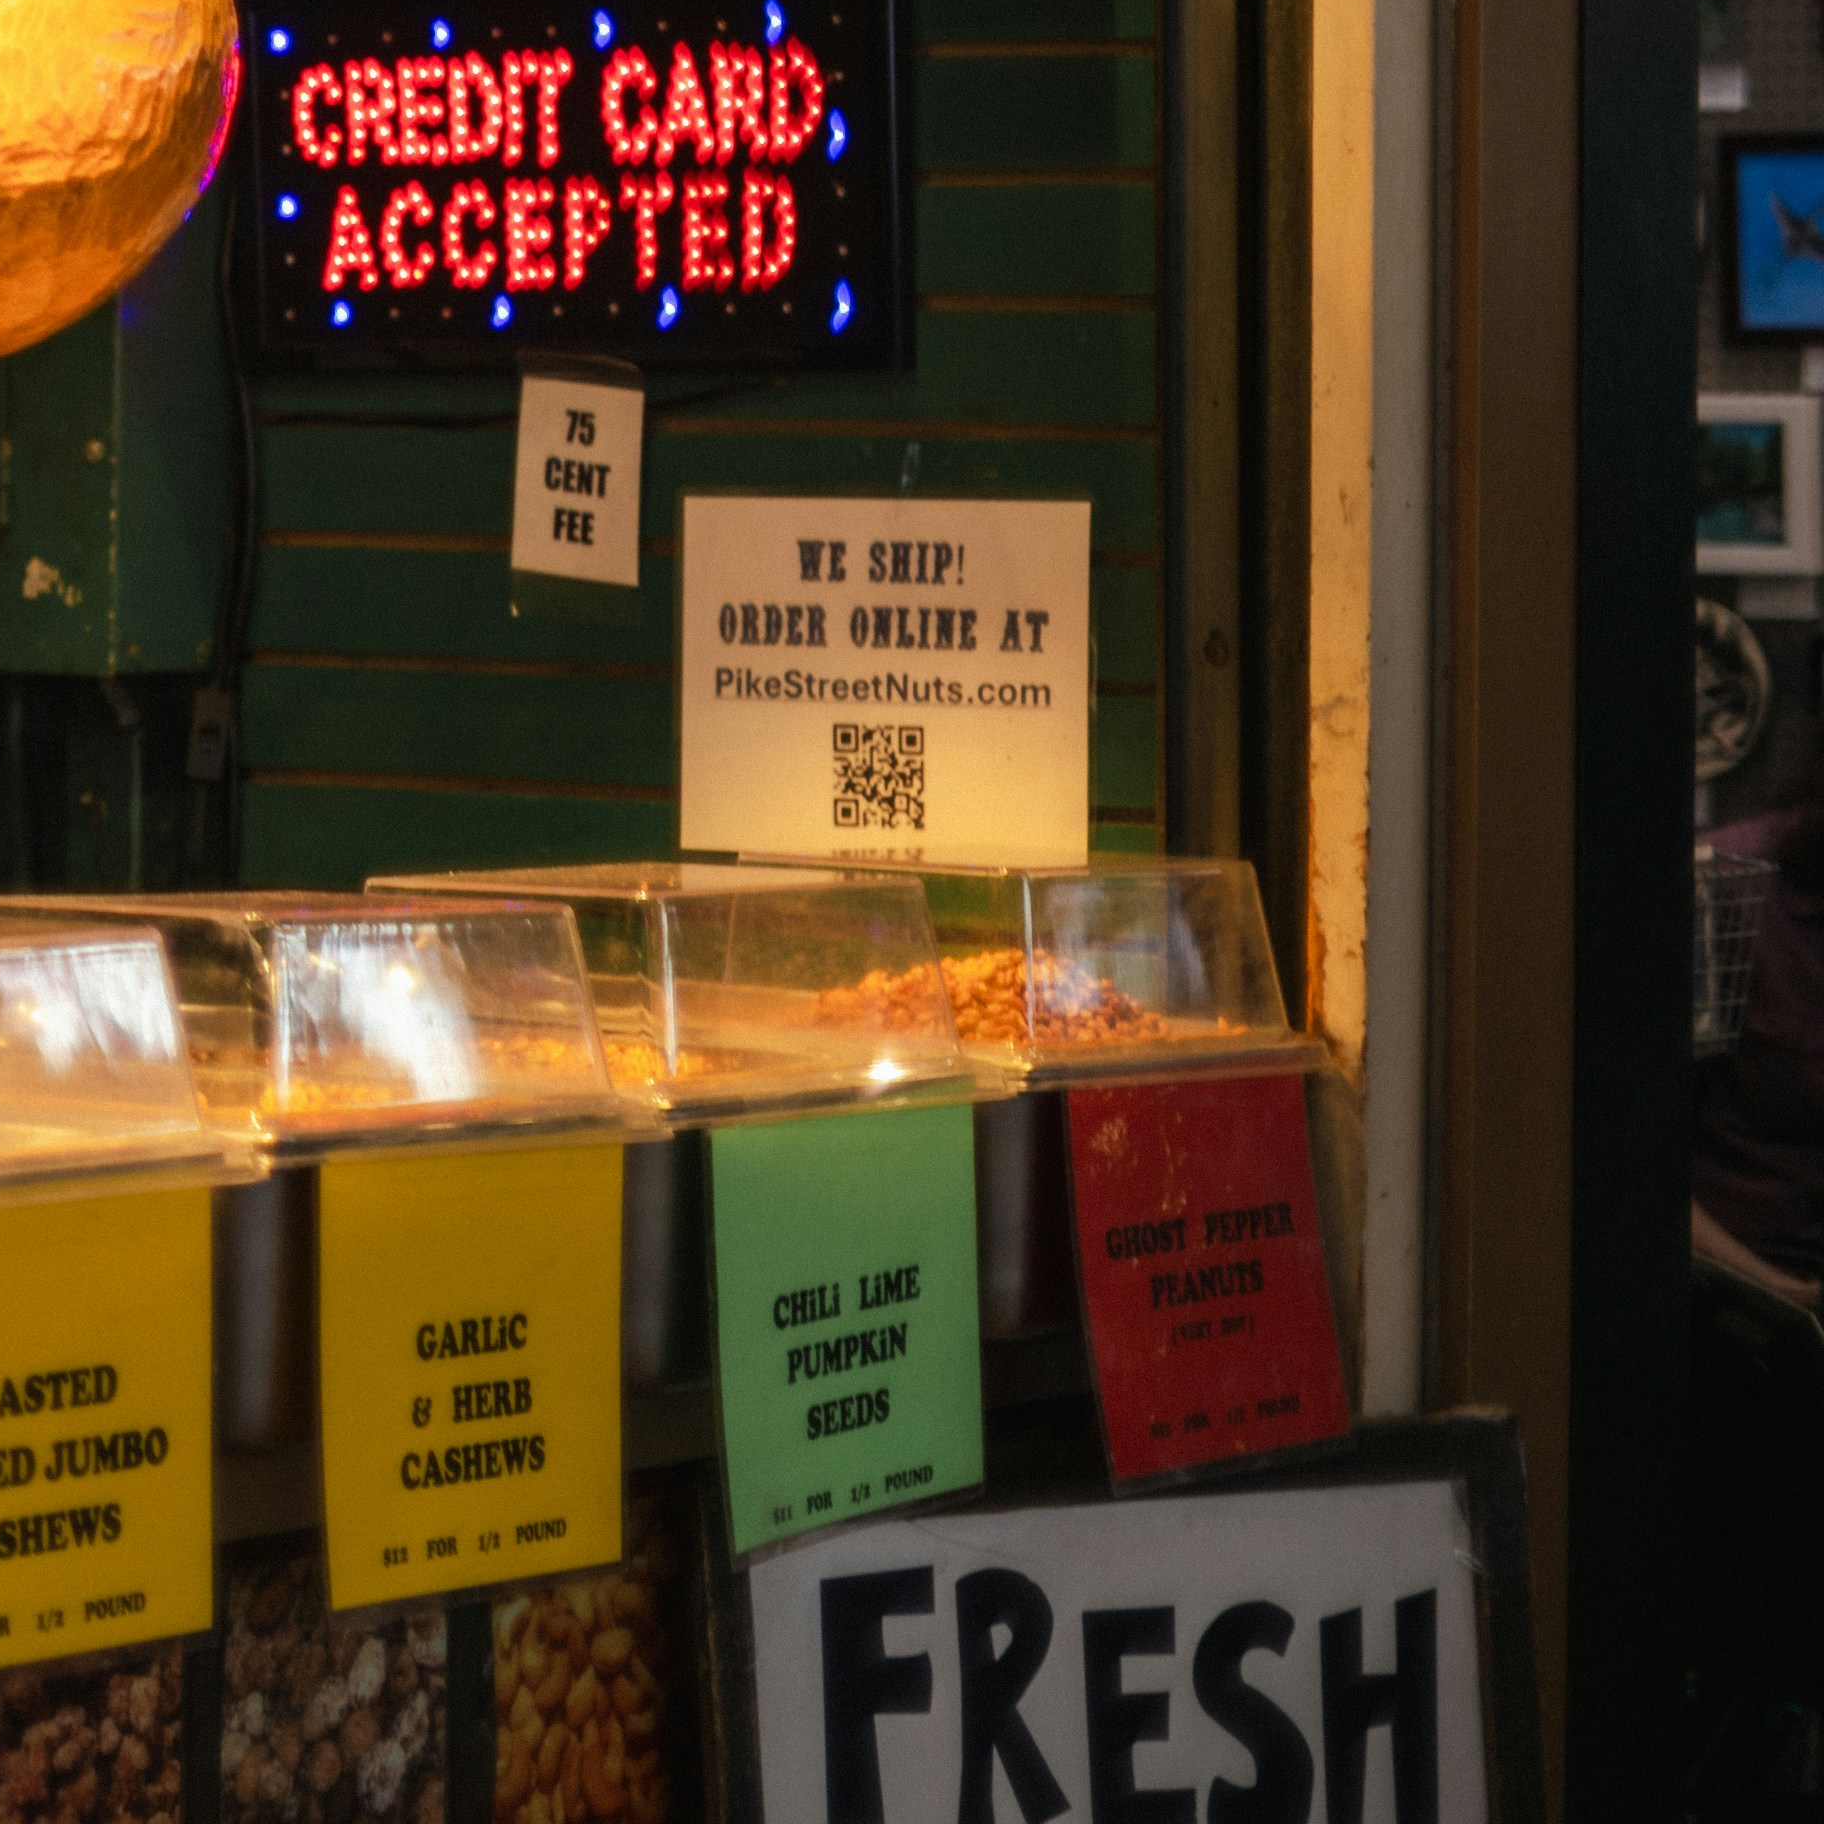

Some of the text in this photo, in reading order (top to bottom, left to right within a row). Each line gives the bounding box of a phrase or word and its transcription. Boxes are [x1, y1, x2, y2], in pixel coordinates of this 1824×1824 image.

[291, 36, 825, 168] CREDIT CARD
[322, 171, 795, 293] ACCEPTED
[564, 409, 596, 446] 75
[543, 456, 611, 498] CENT
[552, 507, 595, 547] FEE
[796, 539, 966, 586] WE SHIP!
[718, 602, 1049, 653] ORDER ONLINE AT
[714, 667, 1052, 708] PikeStreetNuts.com
[1105, 1202, 1295, 1260] GHOST PEPPER
[1149, 1260, 1265, 1309] PEANUTS
[412, 1377, 532, 1428] & HERB
[806, 1388, 891, 1441] SEEDS
[45, 1426, 168, 1482] JUMBO
[400, 1435, 546, 1491] CASHEWS
[807, 1490, 833, 1515] FOR
[884, 1465, 933, 1494] POUND
[383, 1518, 567, 1567] $12 FOR 1/2 POUND
[36, 1608, 65, 1634] 1/2
[84, 1591, 146, 1623] POUND
[819, 1565, 1438, 1824] FRESH
